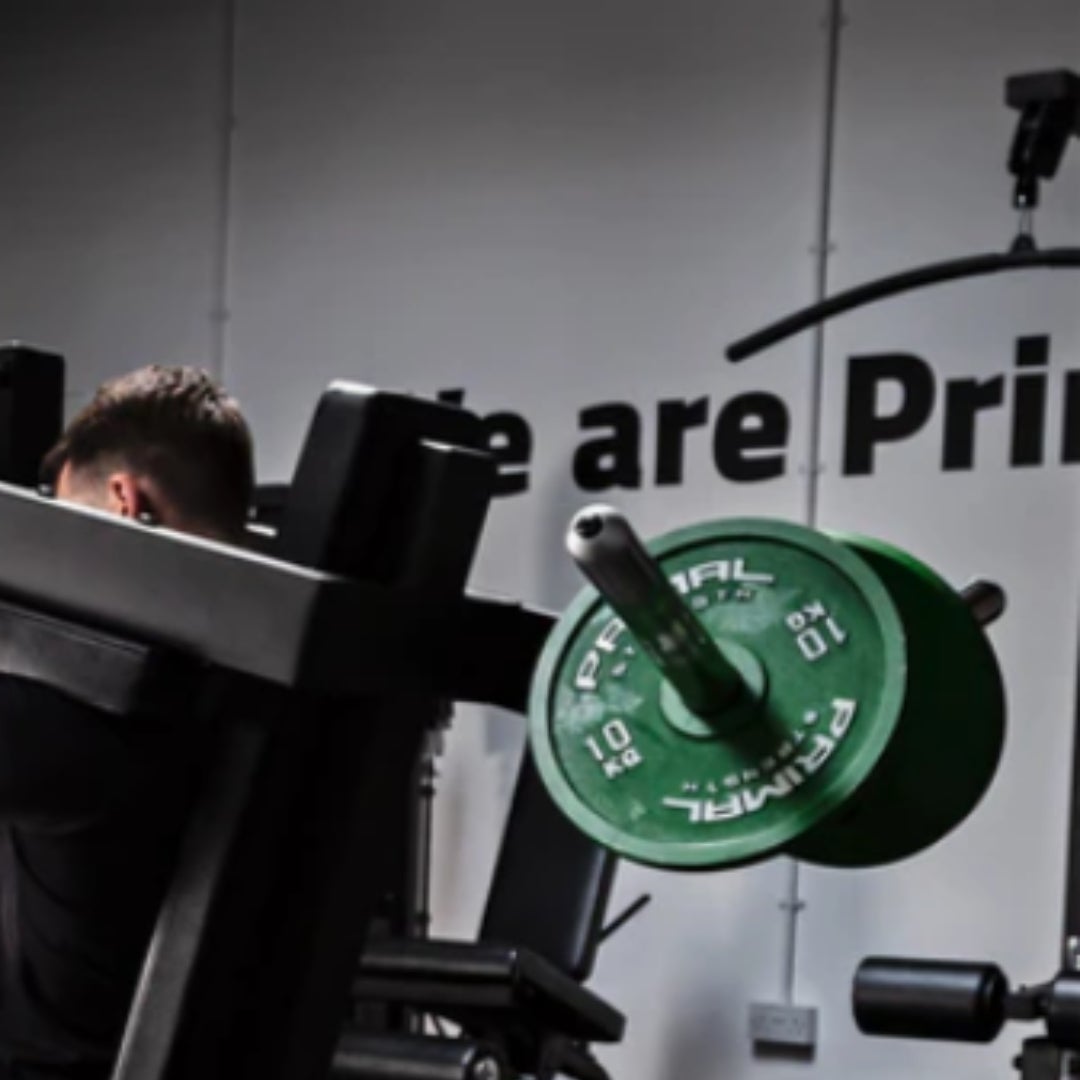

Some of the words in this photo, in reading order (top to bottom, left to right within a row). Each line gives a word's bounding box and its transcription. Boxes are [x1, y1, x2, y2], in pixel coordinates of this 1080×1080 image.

[437, 388, 532, 498] e
[572, 390, 790, 492] are
[796, 615, 848, 662] 10
[584, 718, 633, 760] 10
[663, 698, 857, 824] PRIMAL
